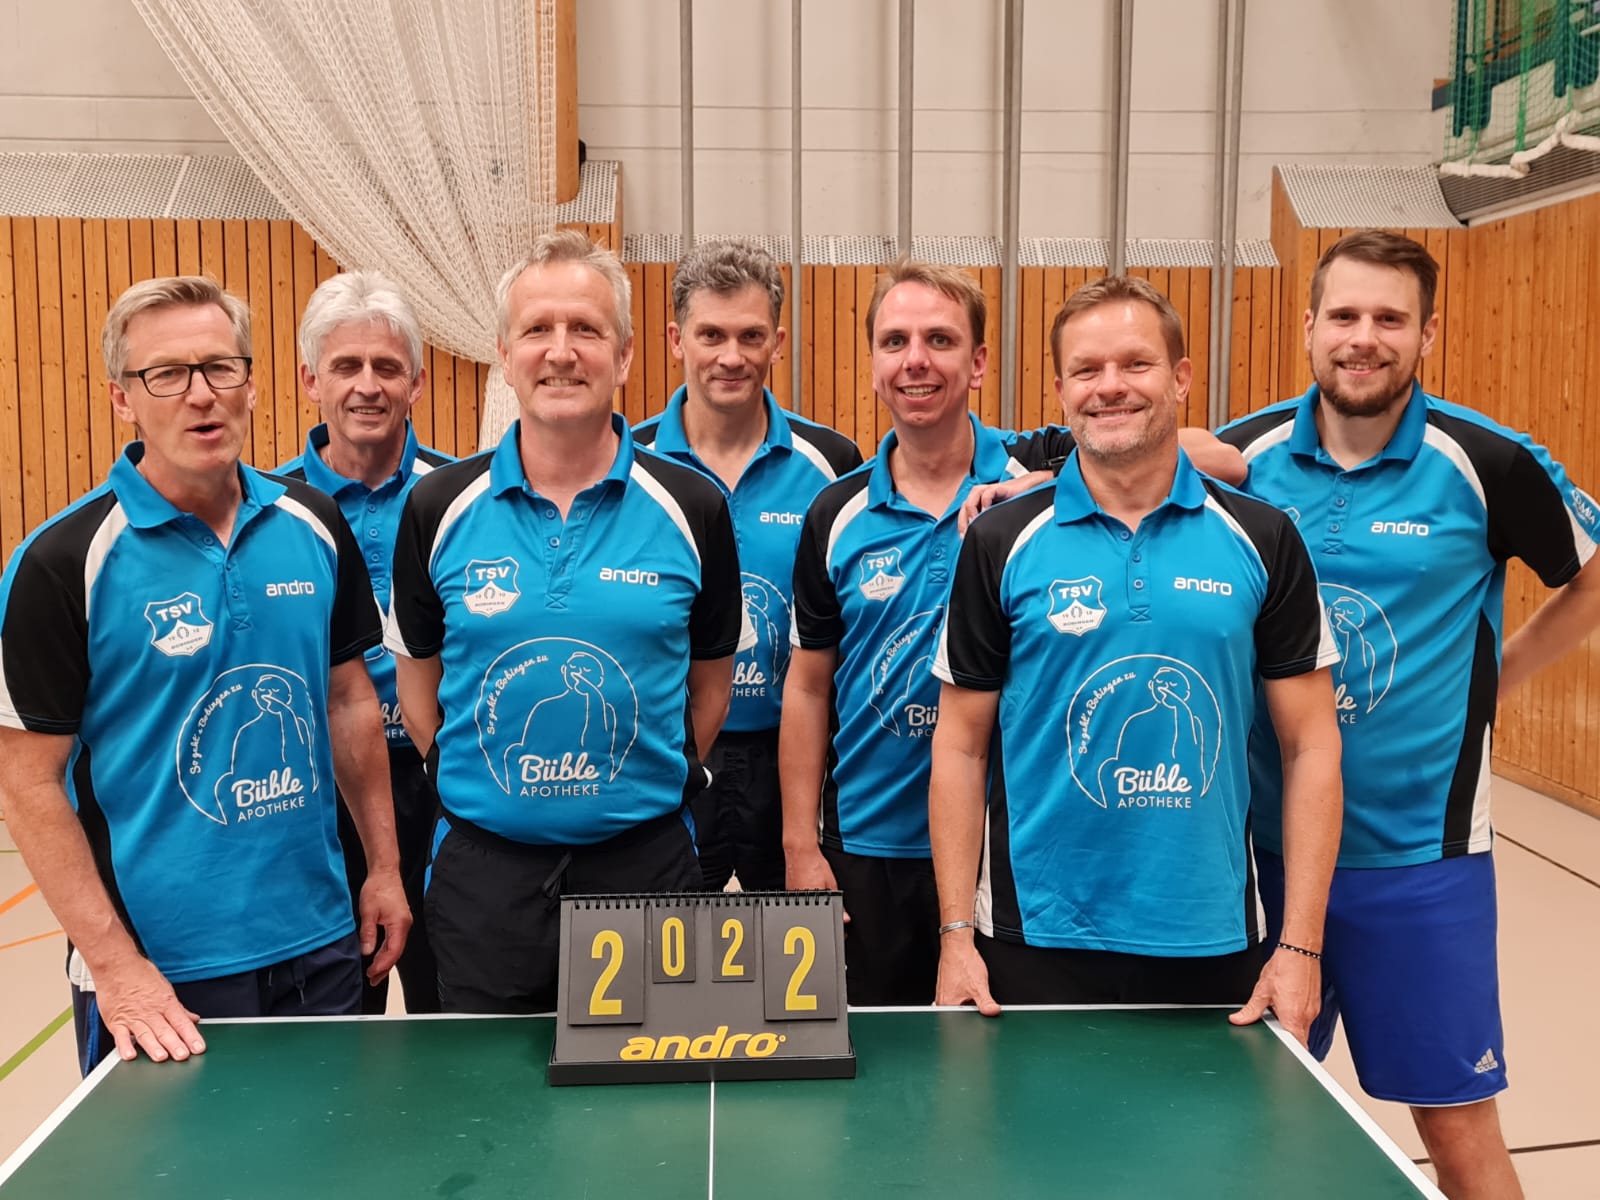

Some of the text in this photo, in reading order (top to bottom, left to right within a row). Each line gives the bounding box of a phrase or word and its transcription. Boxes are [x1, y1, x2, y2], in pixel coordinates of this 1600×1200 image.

[1371, 520, 1430, 536] andro
[867, 555, 895, 570] TSV
[475, 566, 511, 581] TSV
[600, 567, 659, 586] andro
[266, 579, 315, 597] andro
[1058, 584, 1093, 600] TSV
[1174, 577, 1233, 596] andro
[156, 601, 192, 622] TSV
[495, 659, 535, 689] Bobingen
[536, 655, 549, 663] zu
[732, 661, 767, 685] ble
[730, 687, 766, 697] THEKE
[1086, 677, 1123, 710] Bobingen
[1123, 672, 1136, 680] zu
[190, 760, 202, 774] So
[230, 684, 243, 693] zu
[518, 751, 600, 783] Büble
[231, 766, 305, 808] Büble
[1113, 763, 1193, 794] Büble
[519, 784, 600, 797] APOTHEKE
[237, 796, 306, 823] APOTHEKE
[1117, 796, 1192, 809] APOTHEKE
[589, 917, 818, 1016] 2 0 2 2
[619, 1025, 780, 1061] andro
